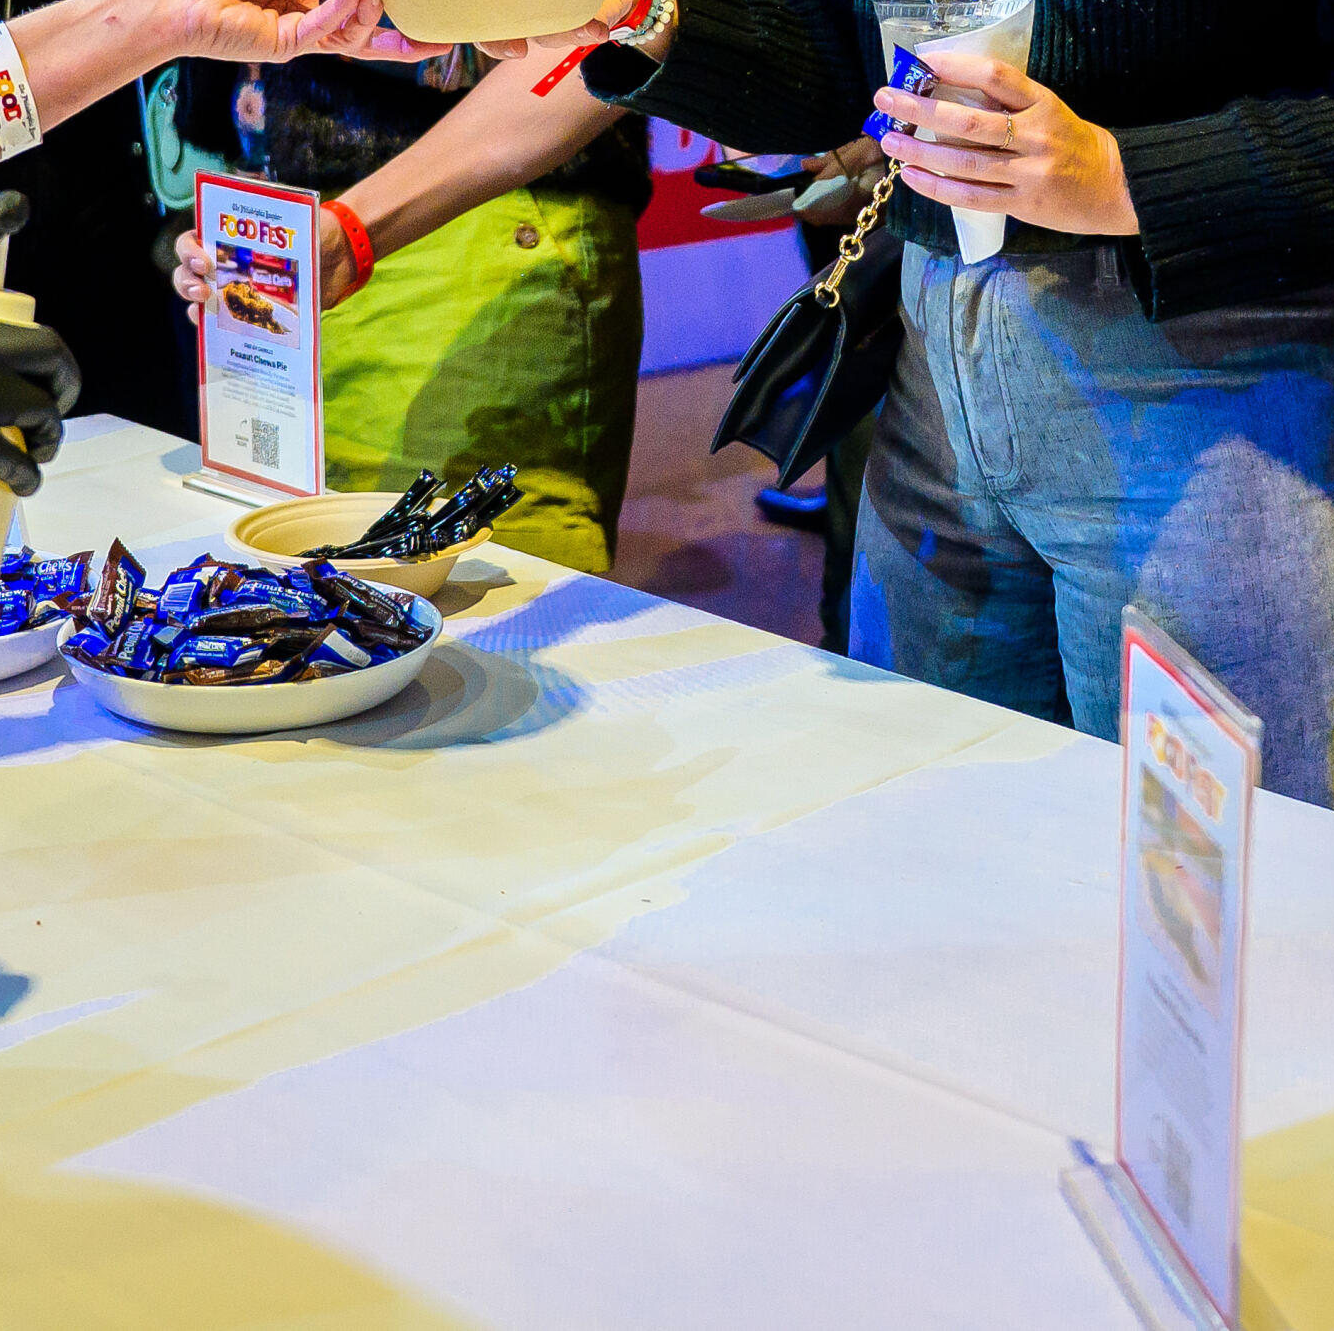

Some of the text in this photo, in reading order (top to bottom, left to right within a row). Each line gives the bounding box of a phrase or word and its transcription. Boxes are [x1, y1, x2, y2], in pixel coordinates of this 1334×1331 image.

[219, 213, 297, 249] FOOD FEST
[230, 348, 253, 363] Peanut
[254, 354, 276, 369] Chews
[276, 360, 288, 371] Pie
[105, 593, 126, 633] Peanut
